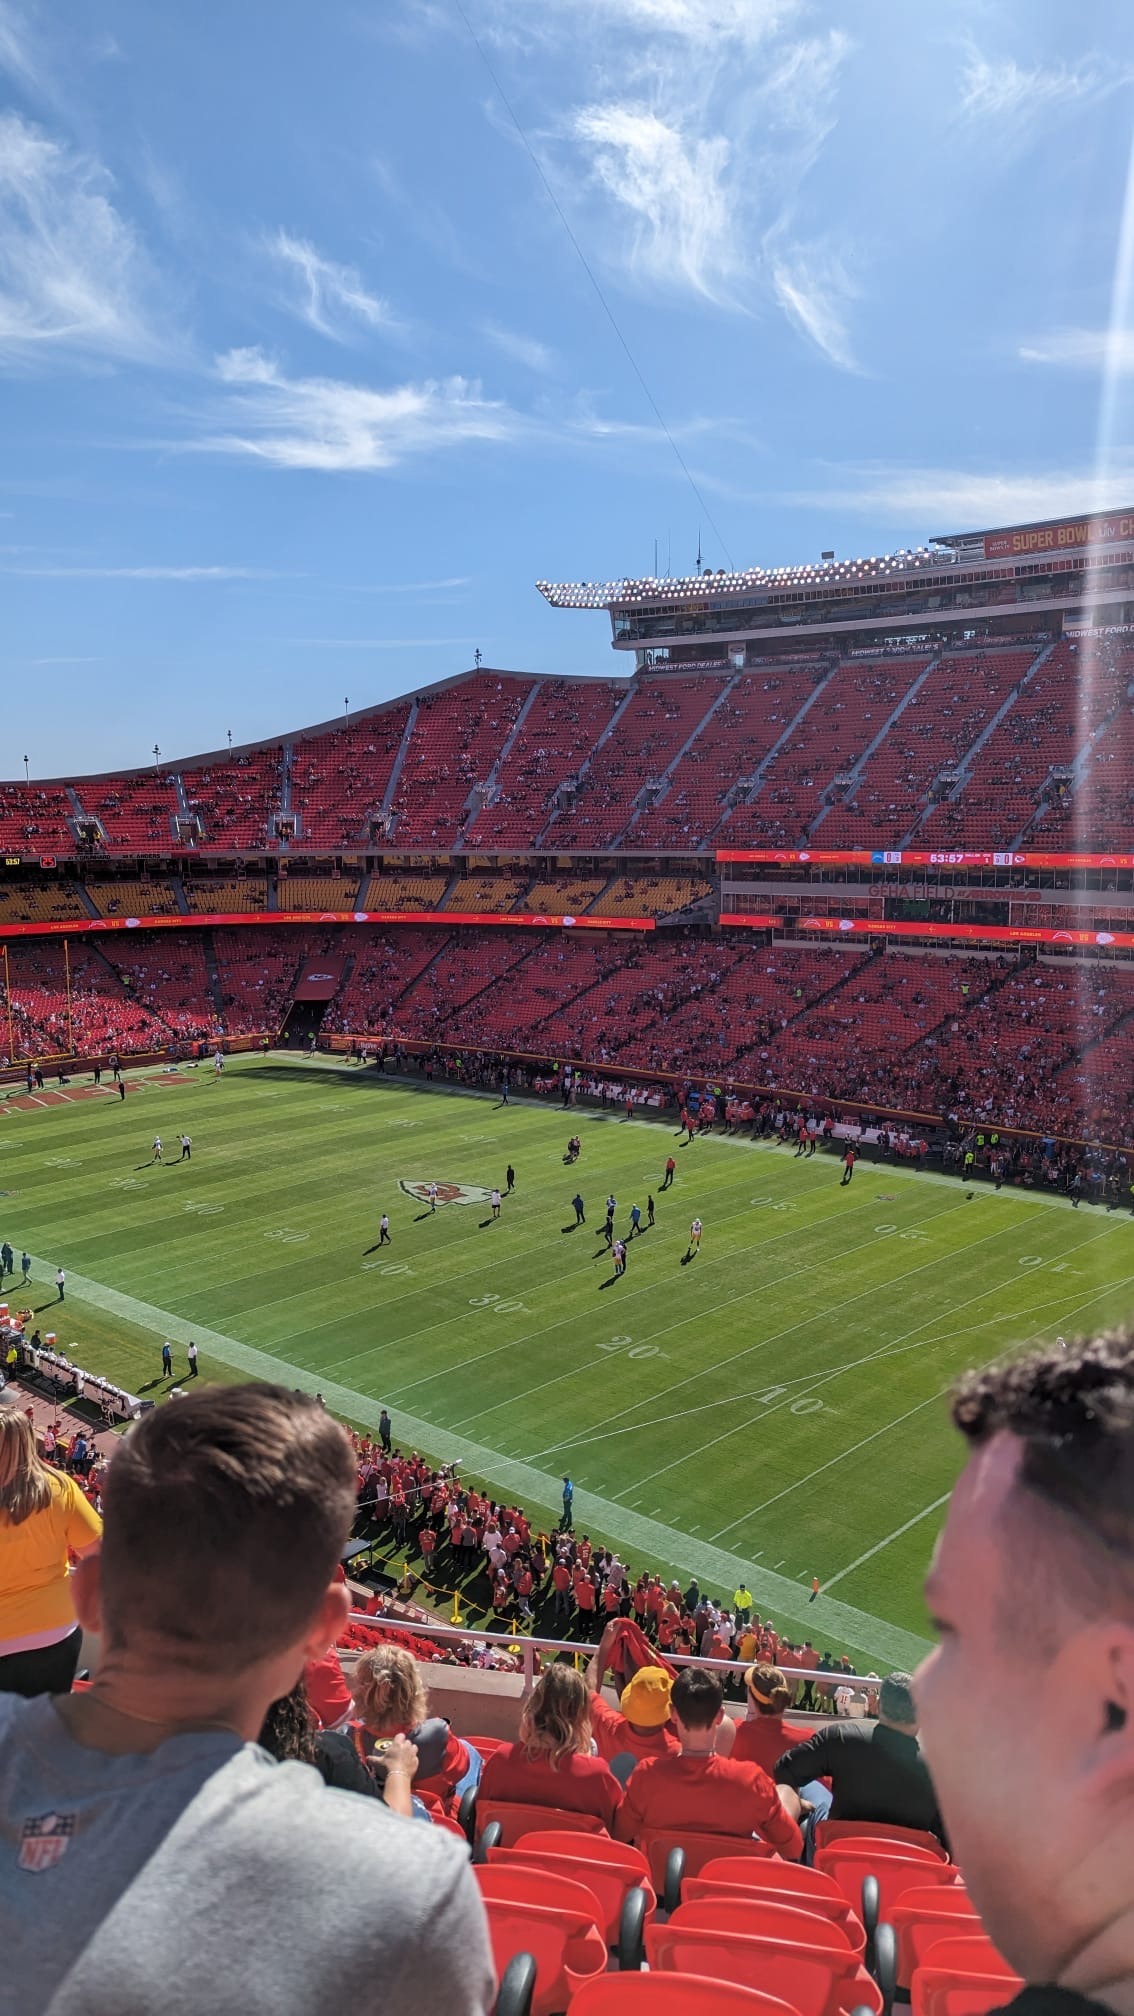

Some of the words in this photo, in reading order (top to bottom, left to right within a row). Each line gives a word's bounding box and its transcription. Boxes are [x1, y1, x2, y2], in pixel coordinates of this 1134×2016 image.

[1013, 530, 1054, 551] SUPER
[1057, 525, 1095, 545] BOWL
[1066, 628, 1104, 638] MIDWEST
[1105, 625, 1129, 635] FORD
[42, 857, 55, 867] 25
[930, 854, 964, 863] 53:57
[868, 885, 909, 898] GEHA
[913, 886, 955, 899] FIELD
[1079, 933, 1089, 941] VS
[263, 1227, 310, 1243] 50
[359, 1259, 410, 1276] 40
[1018, 1255, 1070, 1273] 10
[468, 1293, 524, 1313] 30
[596, 1335, 659, 1359] 20
[751, 1387, 824, 1415] 10
